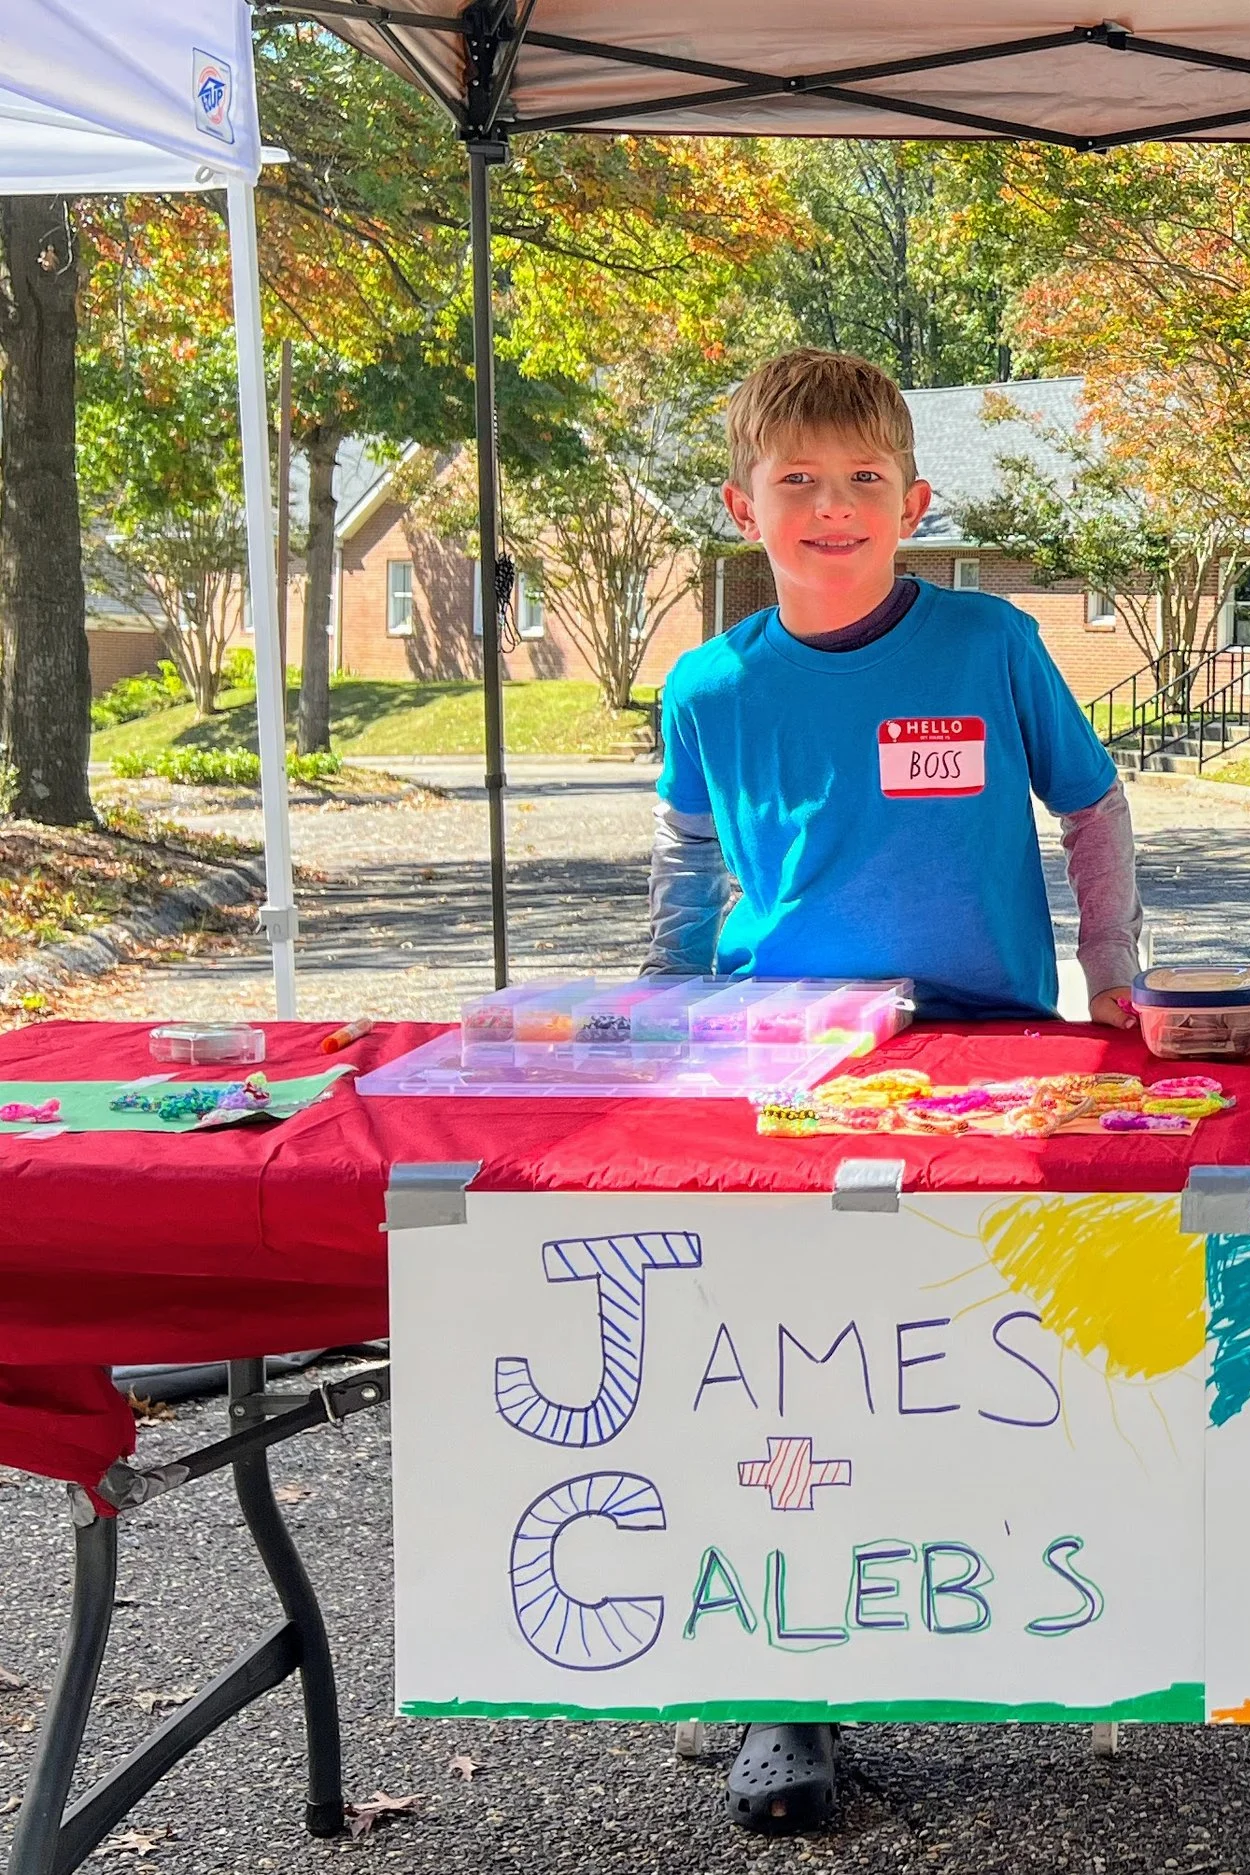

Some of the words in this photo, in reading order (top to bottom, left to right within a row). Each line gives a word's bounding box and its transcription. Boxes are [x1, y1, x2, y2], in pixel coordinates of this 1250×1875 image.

[906, 720, 963, 734] HELLO
[910, 750, 962, 780] BOSS
[495, 1231, 1062, 1448] JAMES
[738, 1437, 852, 1511] +
[509, 1470, 1104, 1672] CALEB'S
